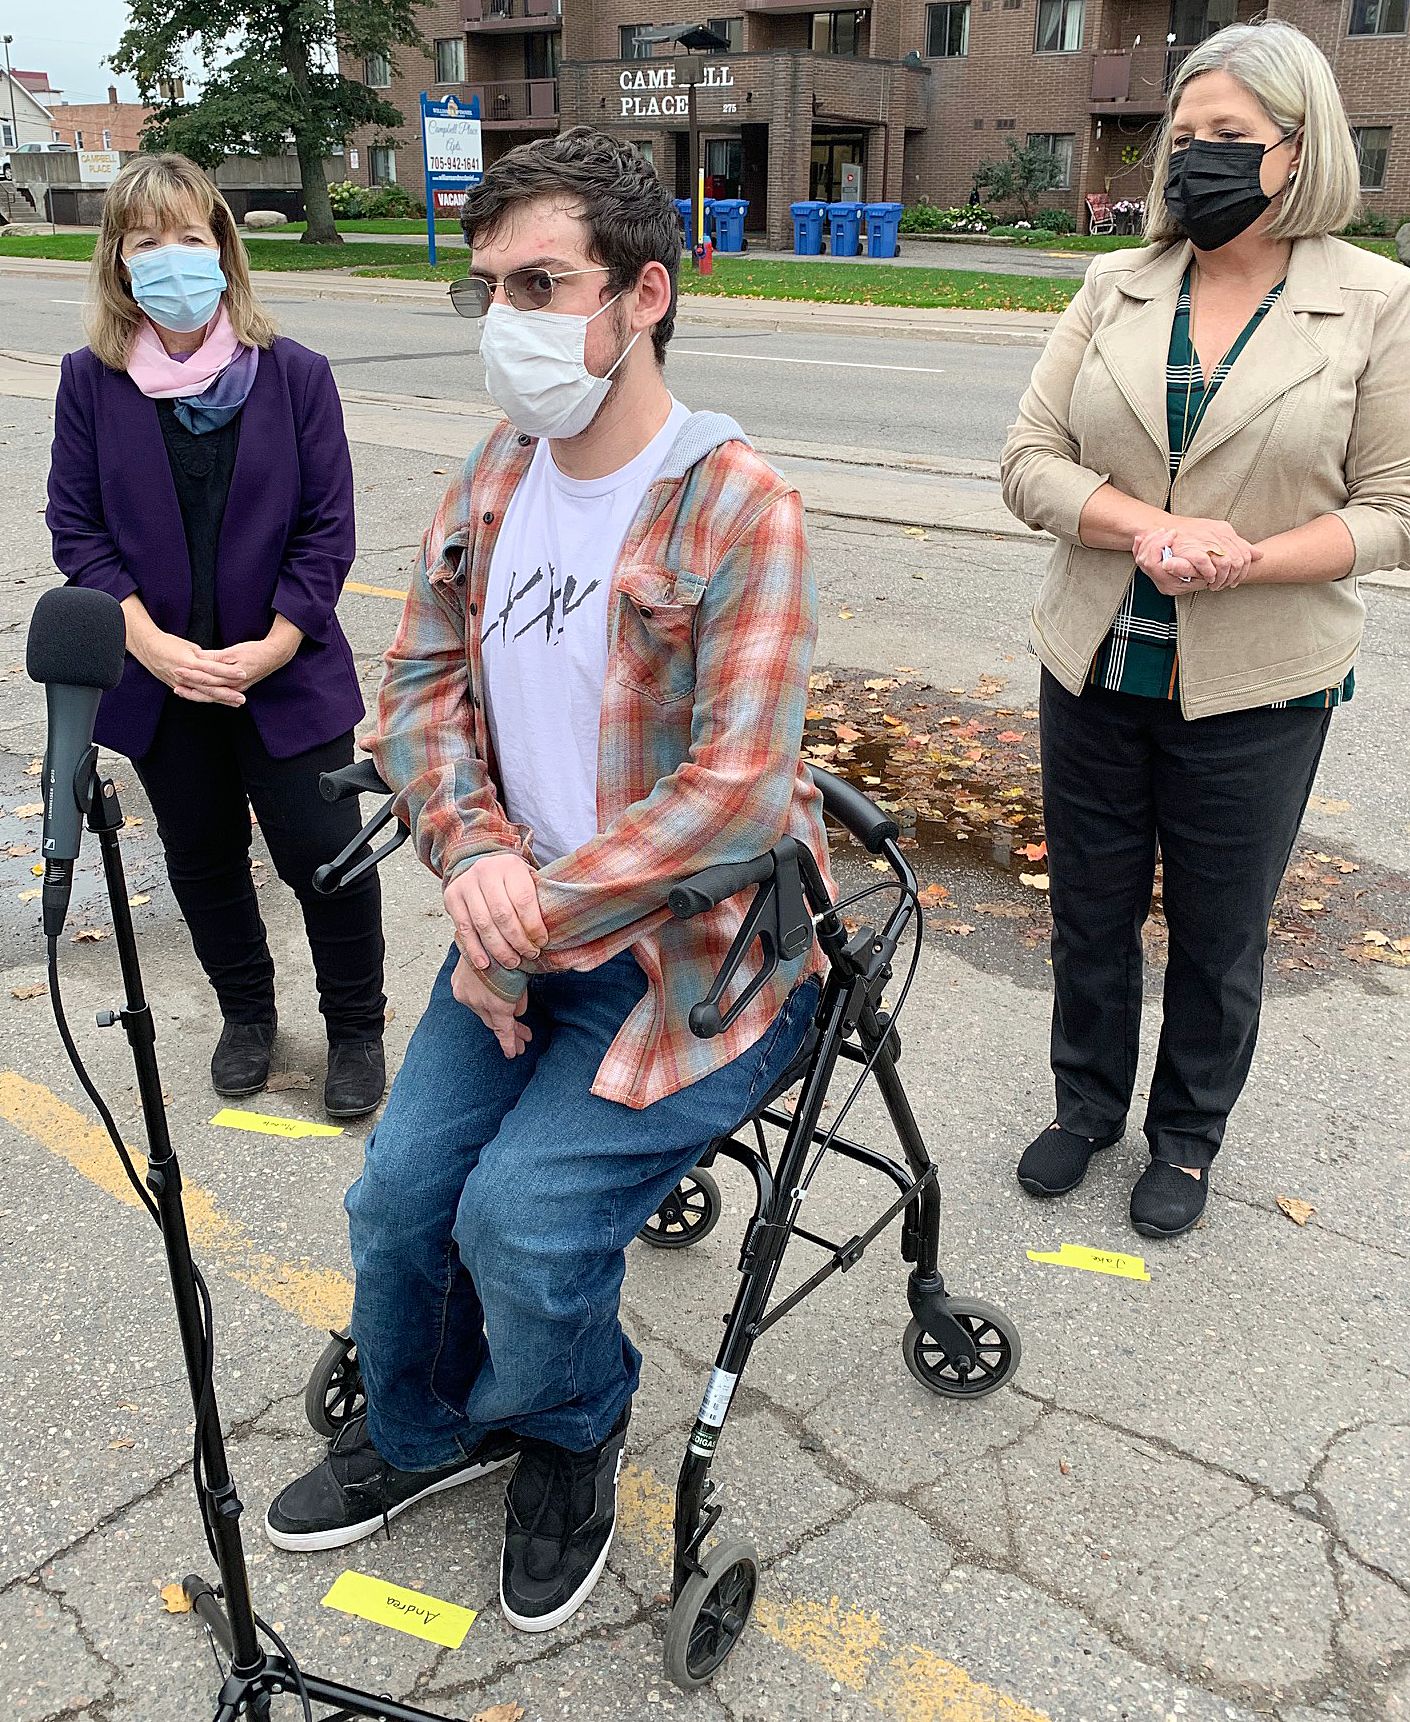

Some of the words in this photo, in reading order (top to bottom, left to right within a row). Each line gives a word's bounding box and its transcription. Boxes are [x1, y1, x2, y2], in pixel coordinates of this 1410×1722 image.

[619, 66, 734, 90] CAMPLL
[620, 95, 689, 116] PLACE
[722, 103, 737, 113] 275
[430, 156, 480, 171] 705-942-1641
[386, 1596, 441, 1625] Andrea
